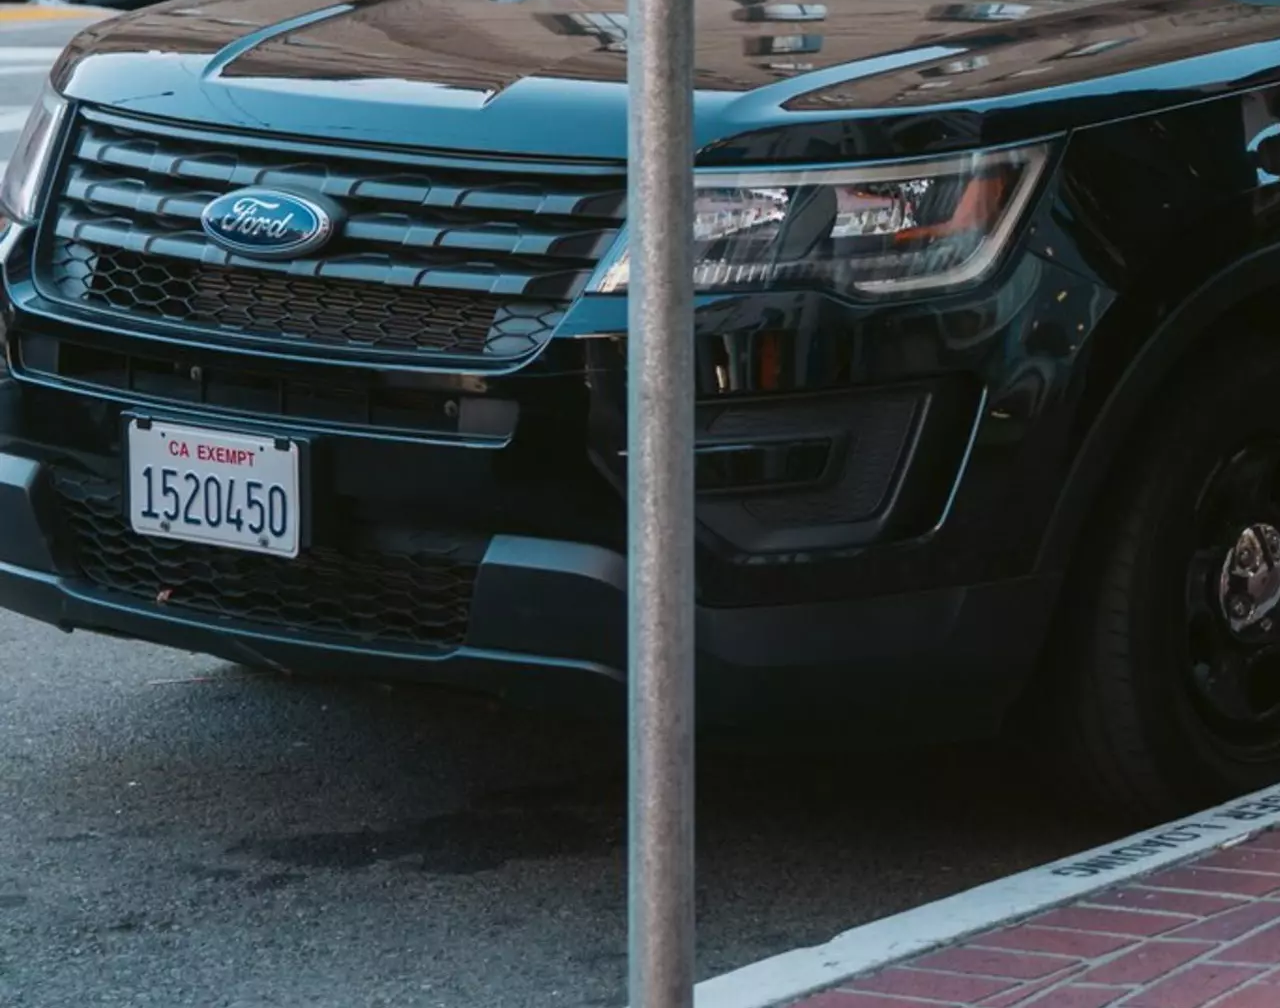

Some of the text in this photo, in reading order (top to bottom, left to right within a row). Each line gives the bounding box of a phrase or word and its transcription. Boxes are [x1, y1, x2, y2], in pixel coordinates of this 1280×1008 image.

[221, 197, 295, 239] Ford
[168, 440, 256, 468] CA EXEMPT
[141, 465, 288, 539] 1520450
[1051, 823, 1227, 878] LOADING
